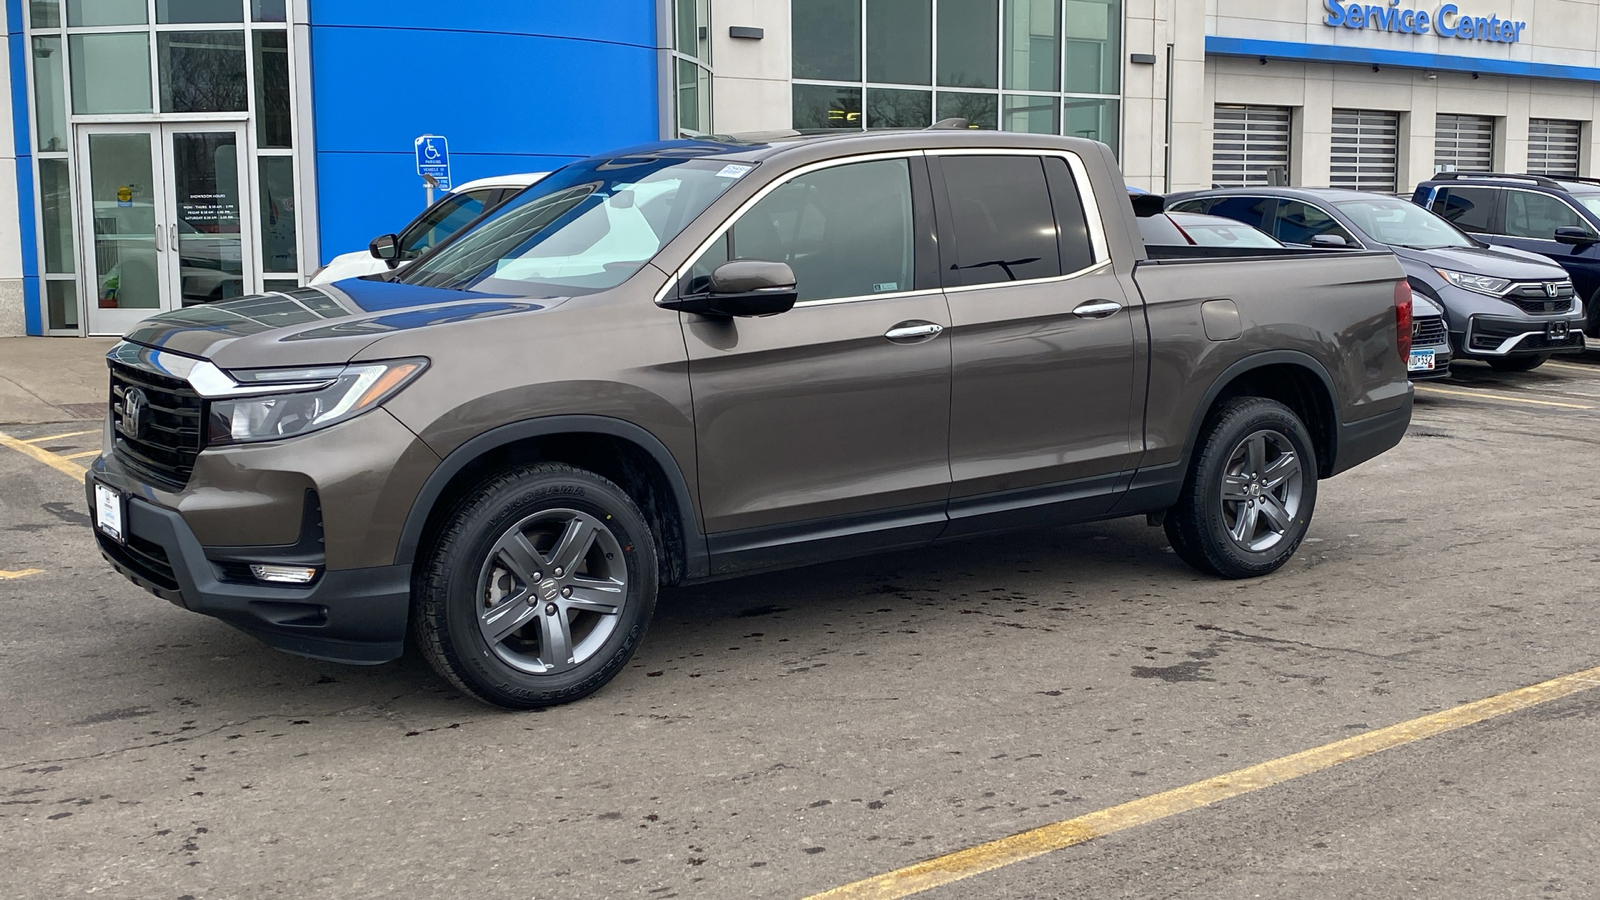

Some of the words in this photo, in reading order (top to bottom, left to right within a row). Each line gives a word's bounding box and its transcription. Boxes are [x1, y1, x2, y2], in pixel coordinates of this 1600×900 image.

[1323, 0, 1430, 34] Service
[1433, 4, 1526, 43] Center
[488, 485, 586, 526] YOKOHAMA
